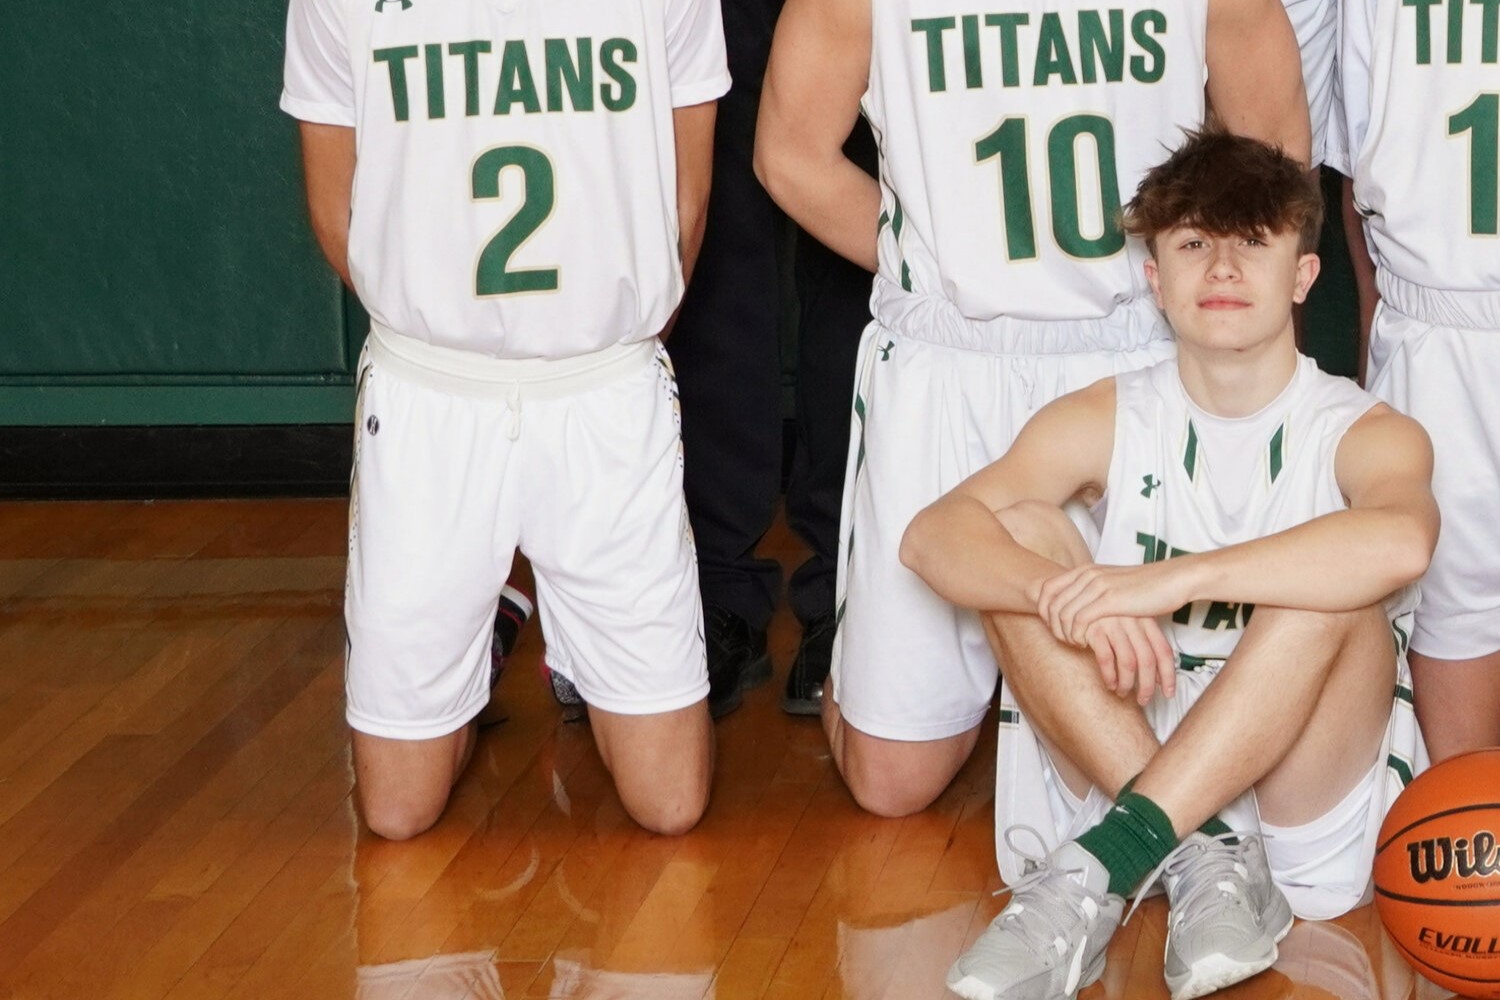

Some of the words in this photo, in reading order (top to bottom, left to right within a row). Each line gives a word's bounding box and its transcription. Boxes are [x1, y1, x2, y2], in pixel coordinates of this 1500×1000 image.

[372, 36, 638, 122] TITANS
[911, 9, 1167, 93] TITANS
[470, 142, 561, 299] 2
[972, 111, 1127, 264] 10
